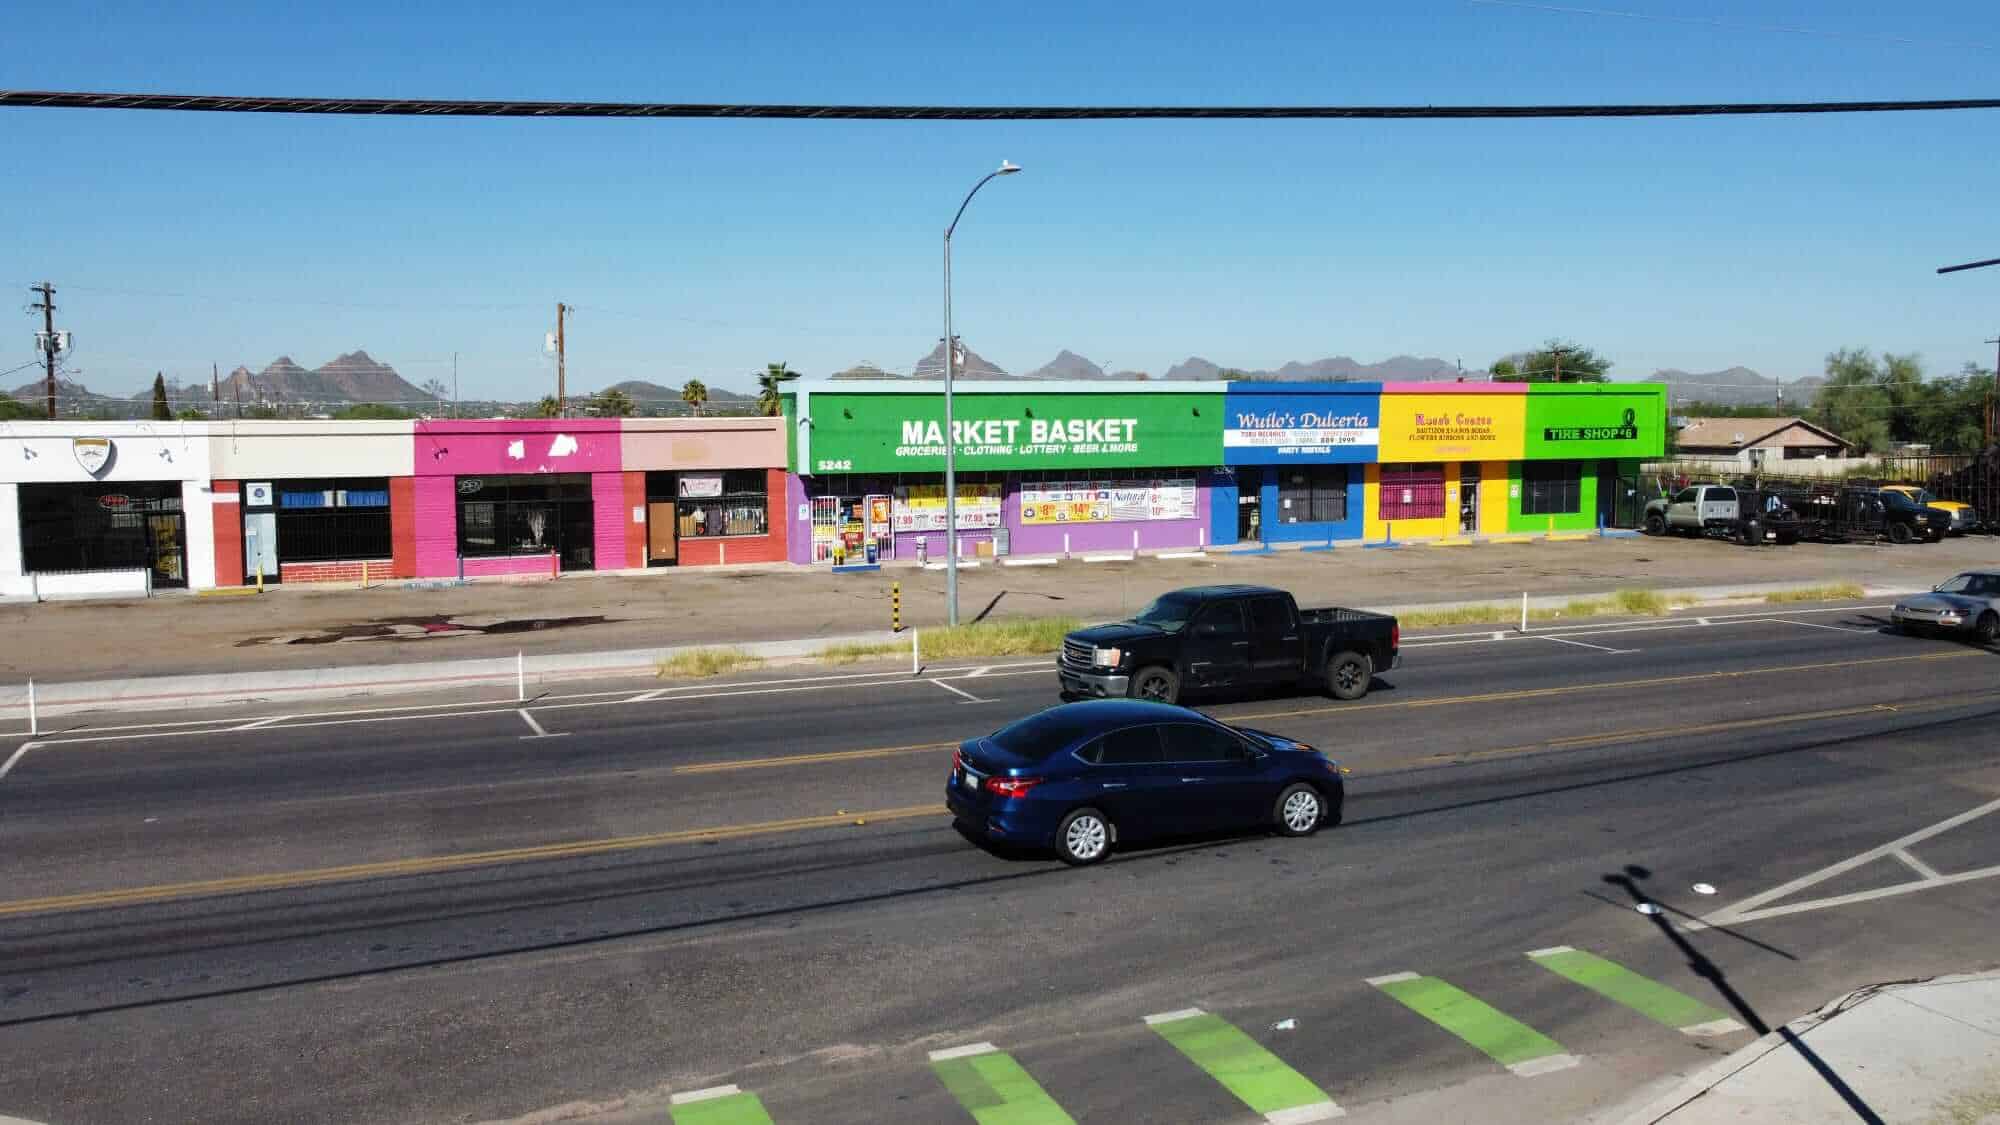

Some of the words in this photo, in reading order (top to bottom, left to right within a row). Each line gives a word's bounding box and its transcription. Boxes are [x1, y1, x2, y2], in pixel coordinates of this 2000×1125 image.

[902, 420, 1020, 445] MARKET
[1031, 419, 1138, 443] BASKET
[1549, 429, 1581, 440] TIRE
[1583, 429, 1618, 439] SHOP
[895, 446, 956, 456] GROCERIE
[963, 445, 1013, 456] CLOTHING
[1019, 444, 1067, 455] LOTTERY
[1072, 443, 1099, 454] BEER
[817, 460, 852, 471] 5242
[1113, 486, 1147, 502] Natural
